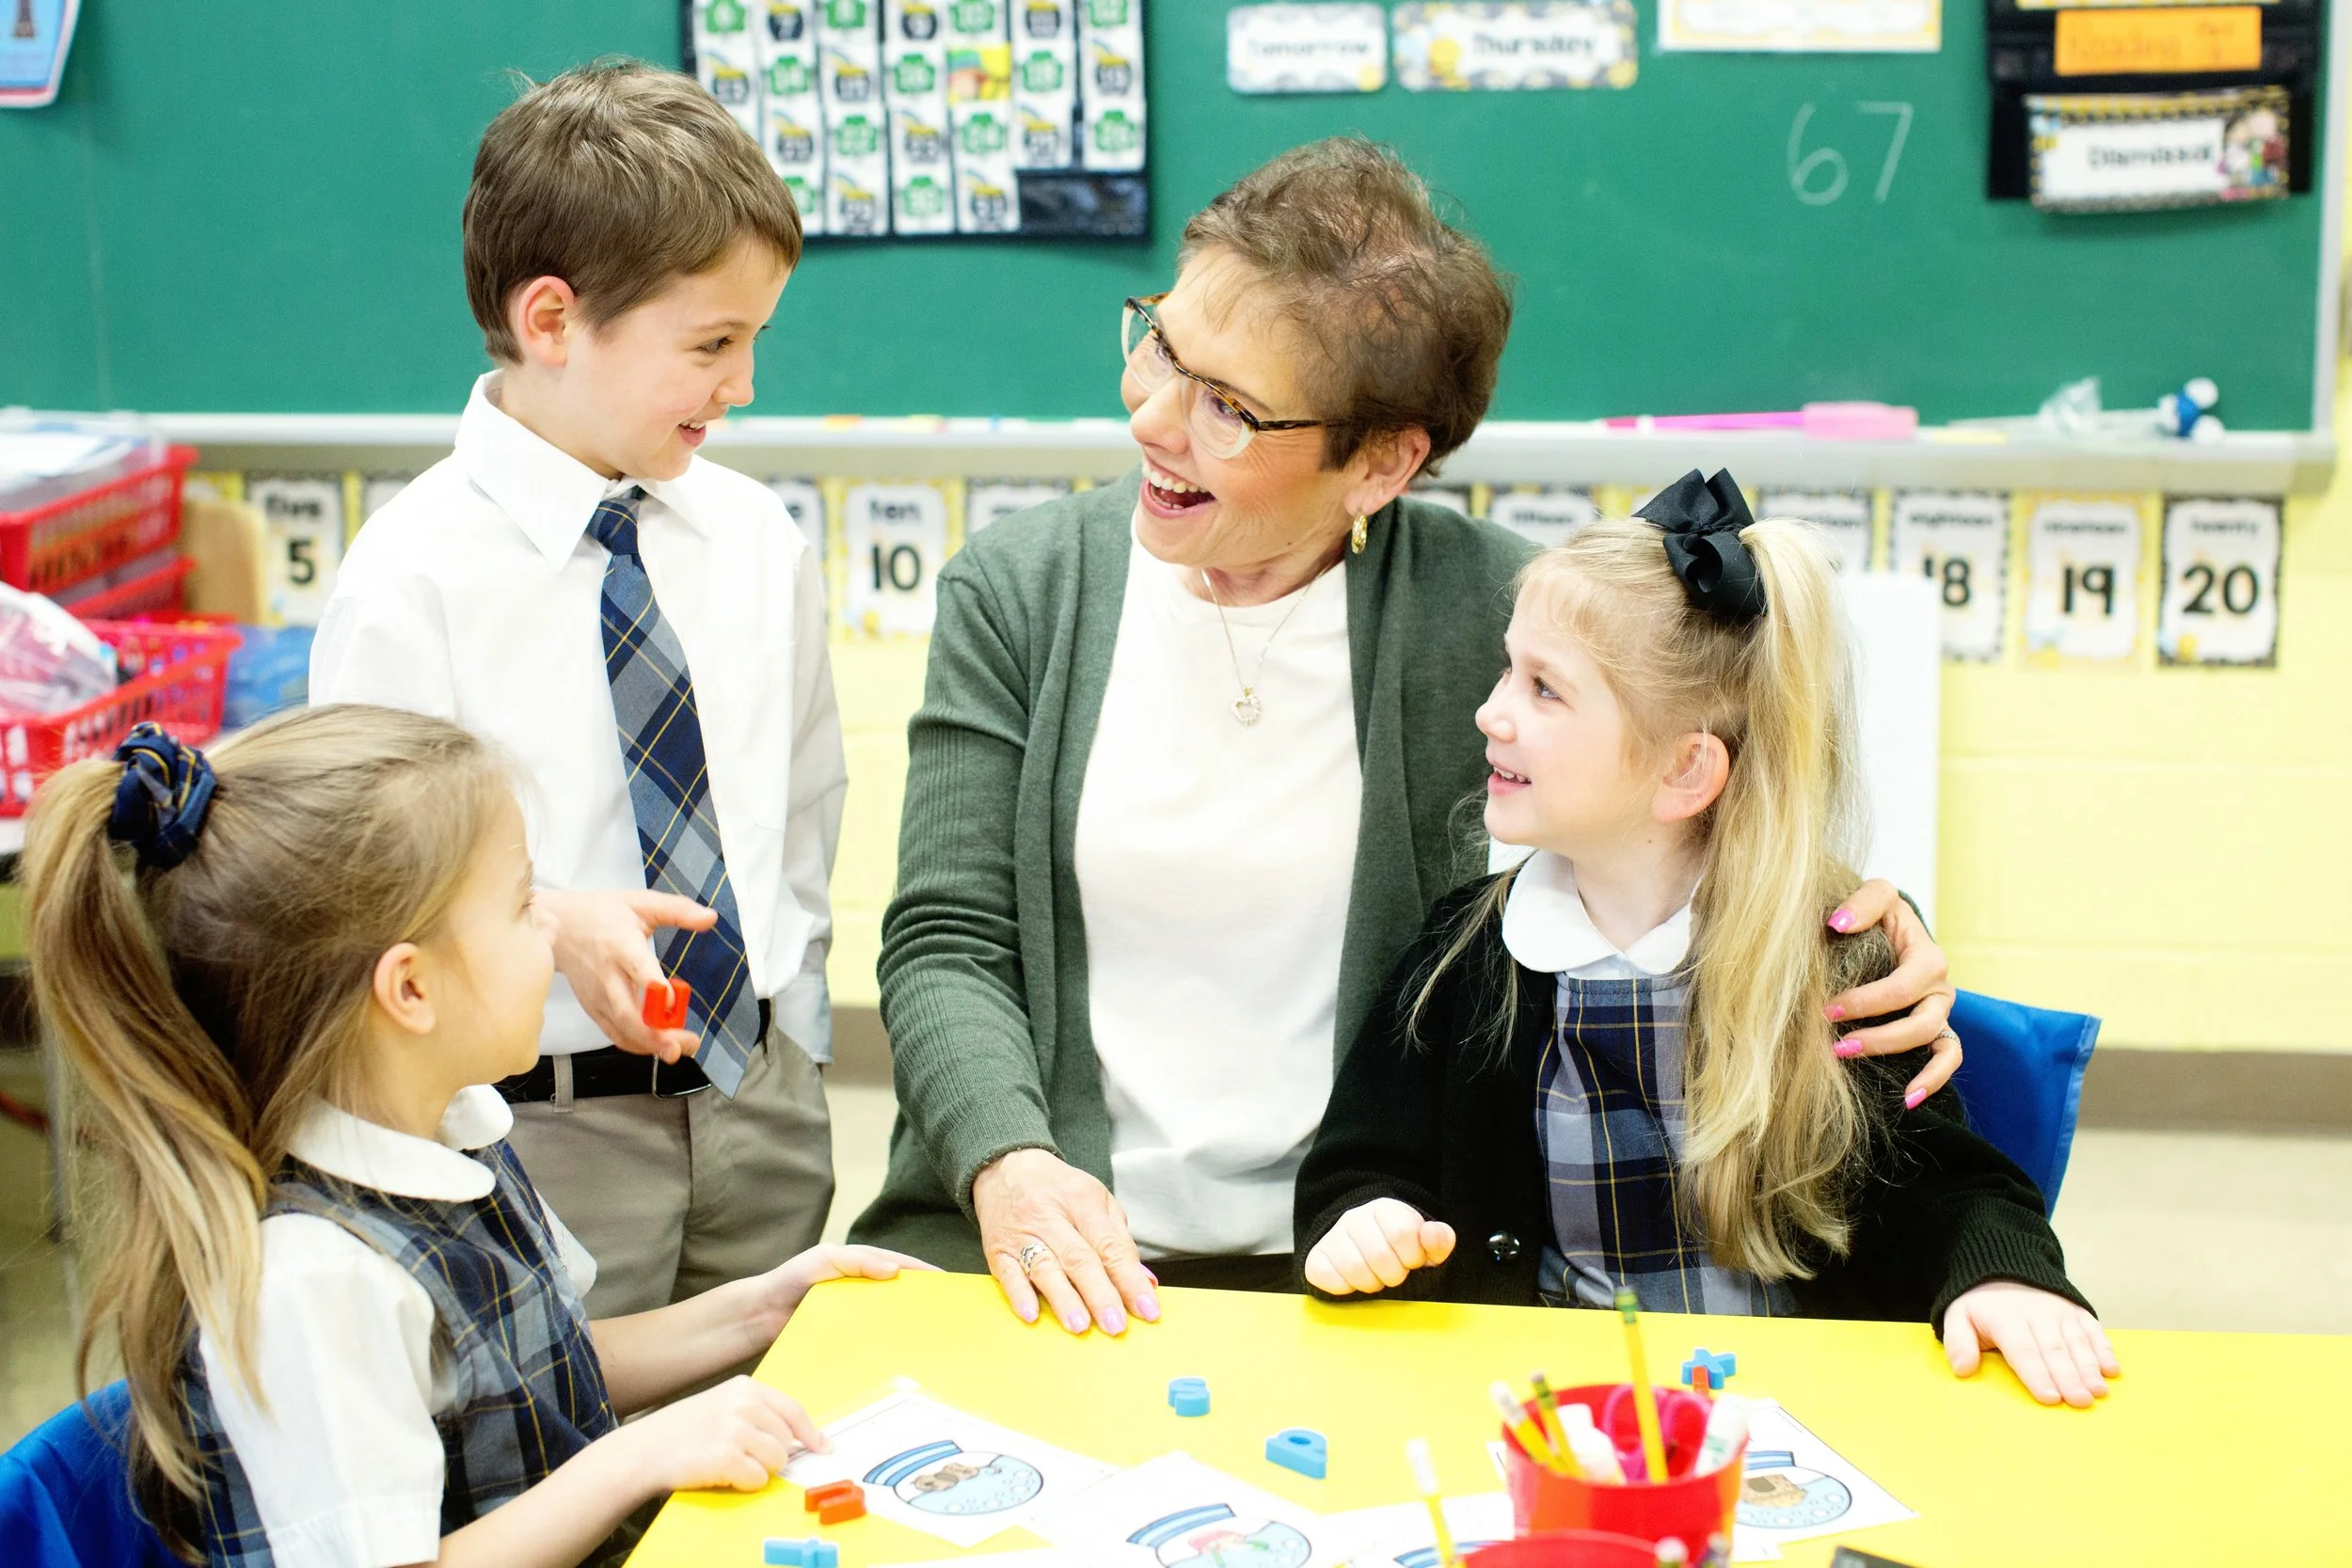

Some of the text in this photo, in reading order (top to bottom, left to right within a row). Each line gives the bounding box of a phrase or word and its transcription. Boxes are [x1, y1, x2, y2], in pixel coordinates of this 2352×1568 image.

[1473, 32, 1595, 58] Thursday
[1787, 101, 1914, 205] 67
[264, 493, 324, 518] five
[869, 499, 921, 521] ten
[288, 539, 315, 586] 5
[871, 544, 921, 591] 10
[2062, 565, 2114, 615] 19
[2183, 564, 2259, 614] 20
